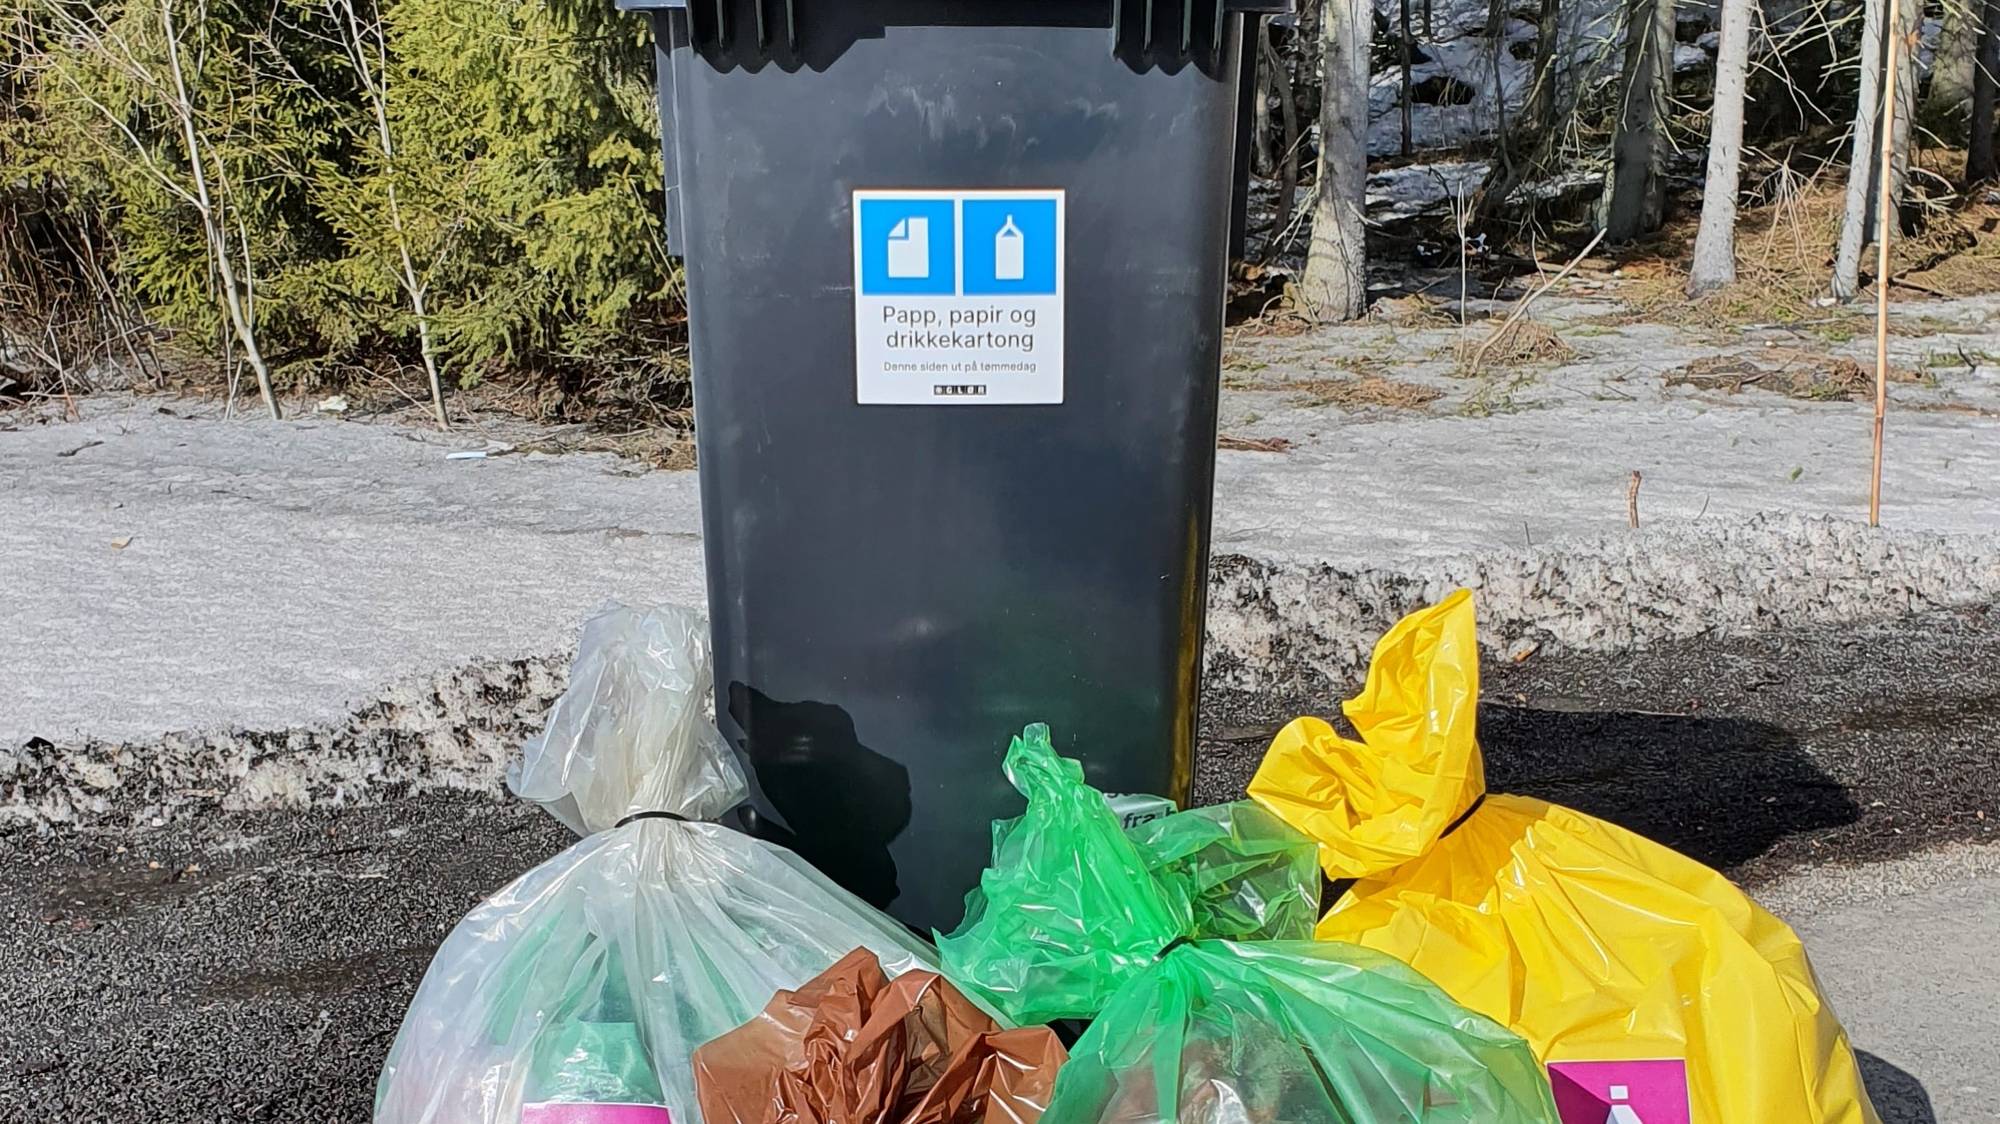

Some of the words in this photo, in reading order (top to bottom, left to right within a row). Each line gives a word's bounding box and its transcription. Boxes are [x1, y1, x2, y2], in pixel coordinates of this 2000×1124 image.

[883, 305, 942, 328] Papp,
[950, 305, 1004, 328] papir
[1010, 309, 1036, 328] og
[886, 330, 1034, 353] drikkekartong
[883, 361, 917, 372] Denne
[920, 361, 949, 372] siden
[951, 361, 962, 372] ut
[964, 359, 978, 374] på
[980, 361, 1037, 374] tømmedag
